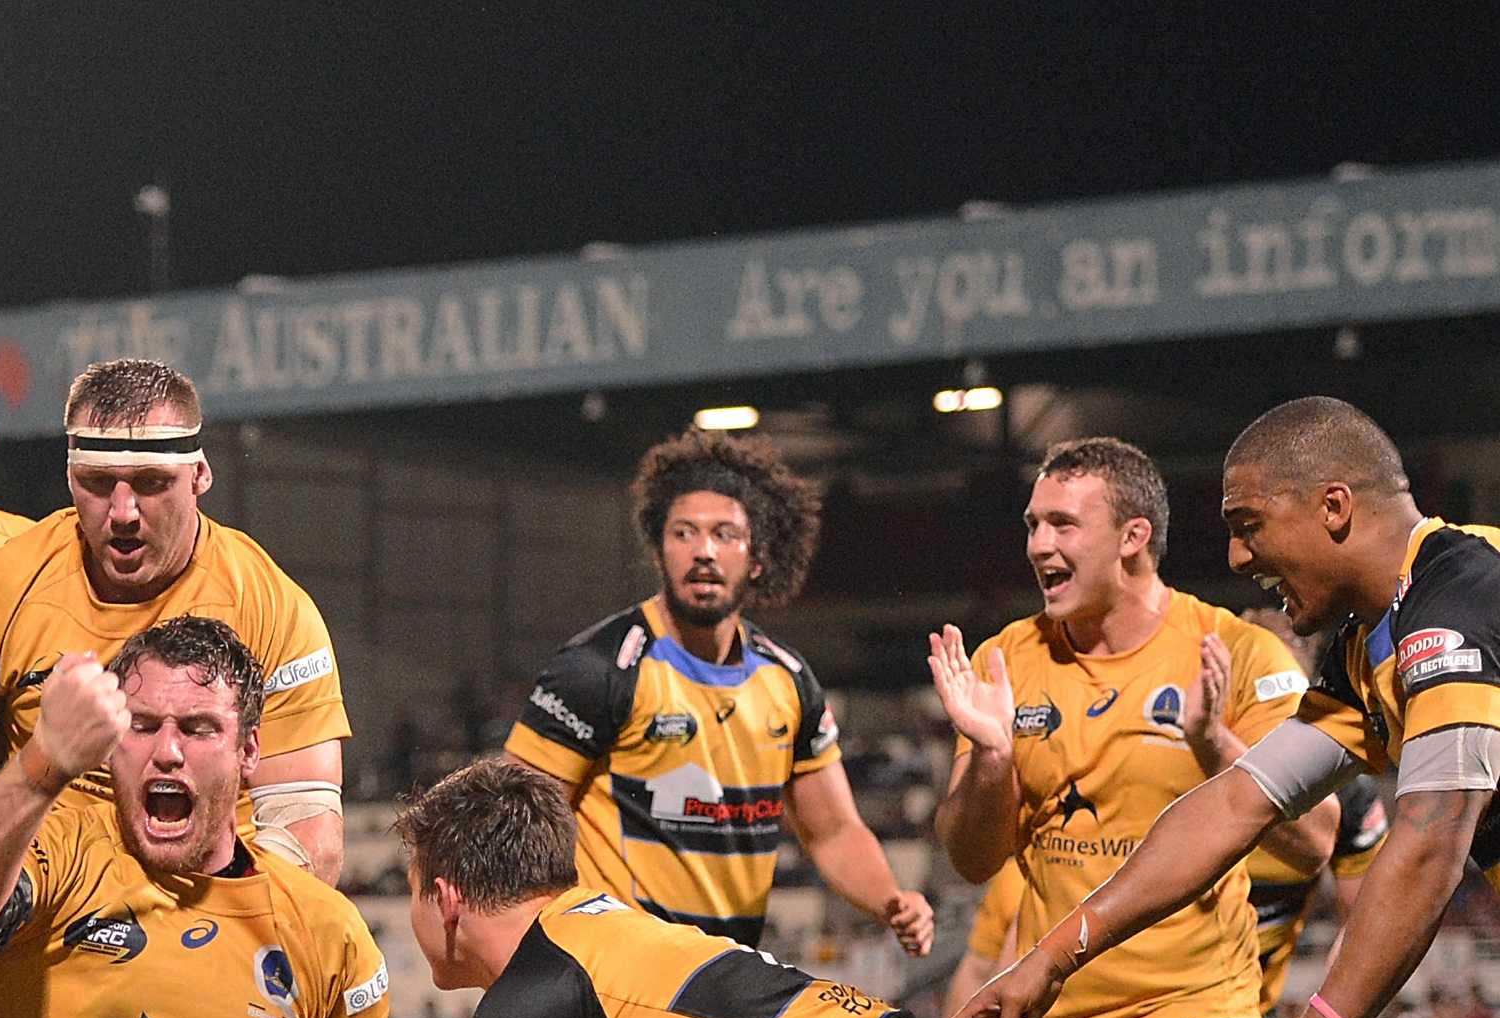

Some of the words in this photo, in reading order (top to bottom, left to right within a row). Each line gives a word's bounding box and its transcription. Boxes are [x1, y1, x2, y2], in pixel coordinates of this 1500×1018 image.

[210, 277, 650, 392] AUSTRALIAN
[727, 240, 866, 340] Are
[886, 246, 1032, 358] you
[1058, 236, 1162, 312] an
[280, 656, 329, 686] Lifelin
